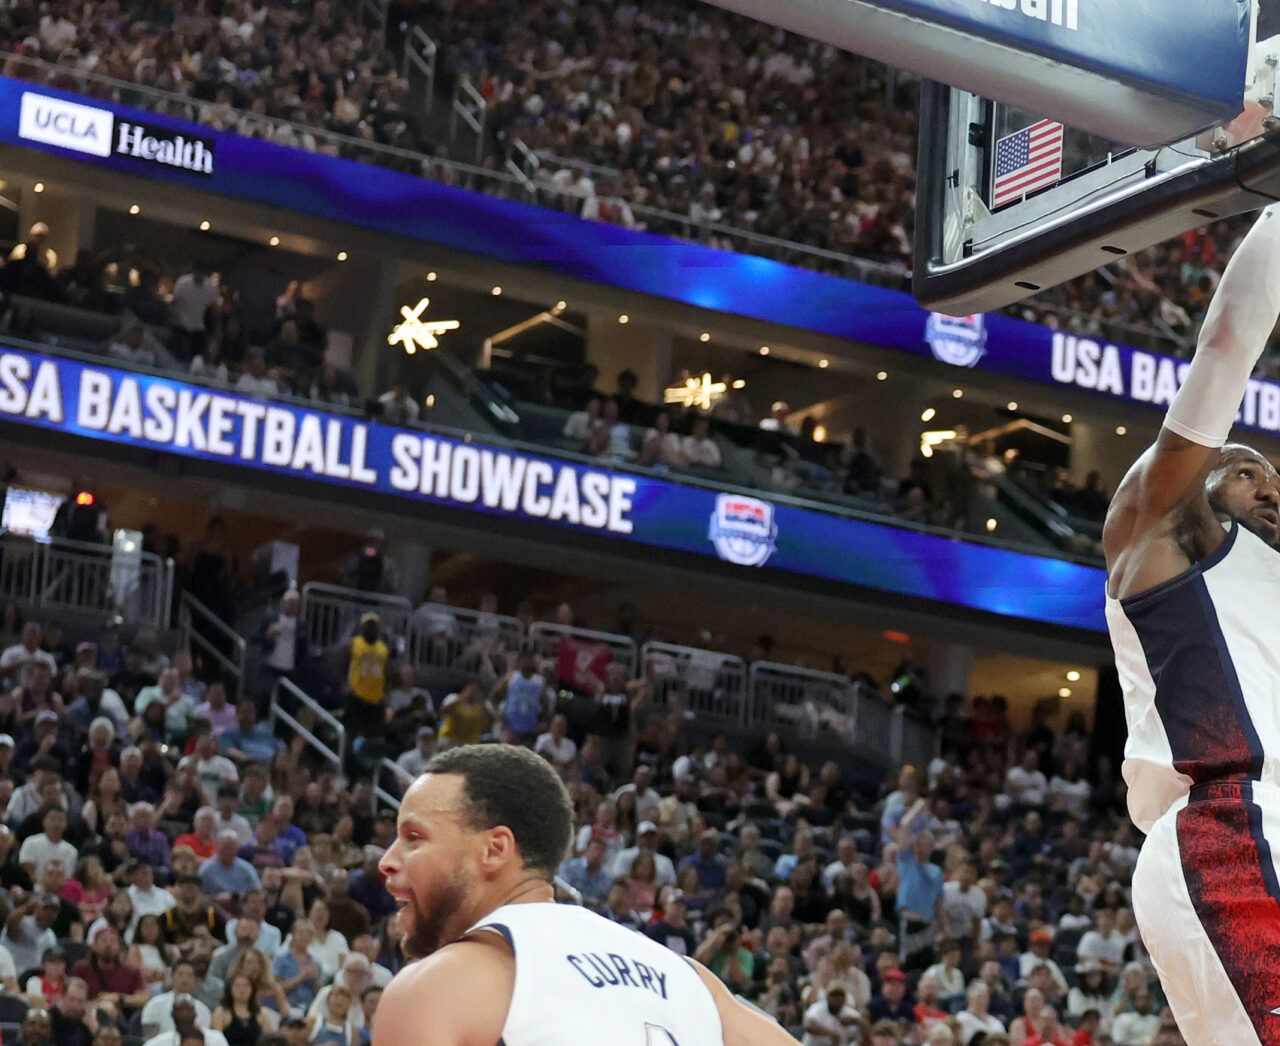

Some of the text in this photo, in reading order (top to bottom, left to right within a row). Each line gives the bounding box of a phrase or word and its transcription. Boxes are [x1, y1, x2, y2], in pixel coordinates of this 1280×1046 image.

[34, 108, 214, 174] UCLA Health
[1051, 332, 1124, 396] USA
[76, 368, 377, 484] BASKETBALL
[389, 432, 636, 535] SHOWCASE
[566, 952, 668, 1001] CURRY
